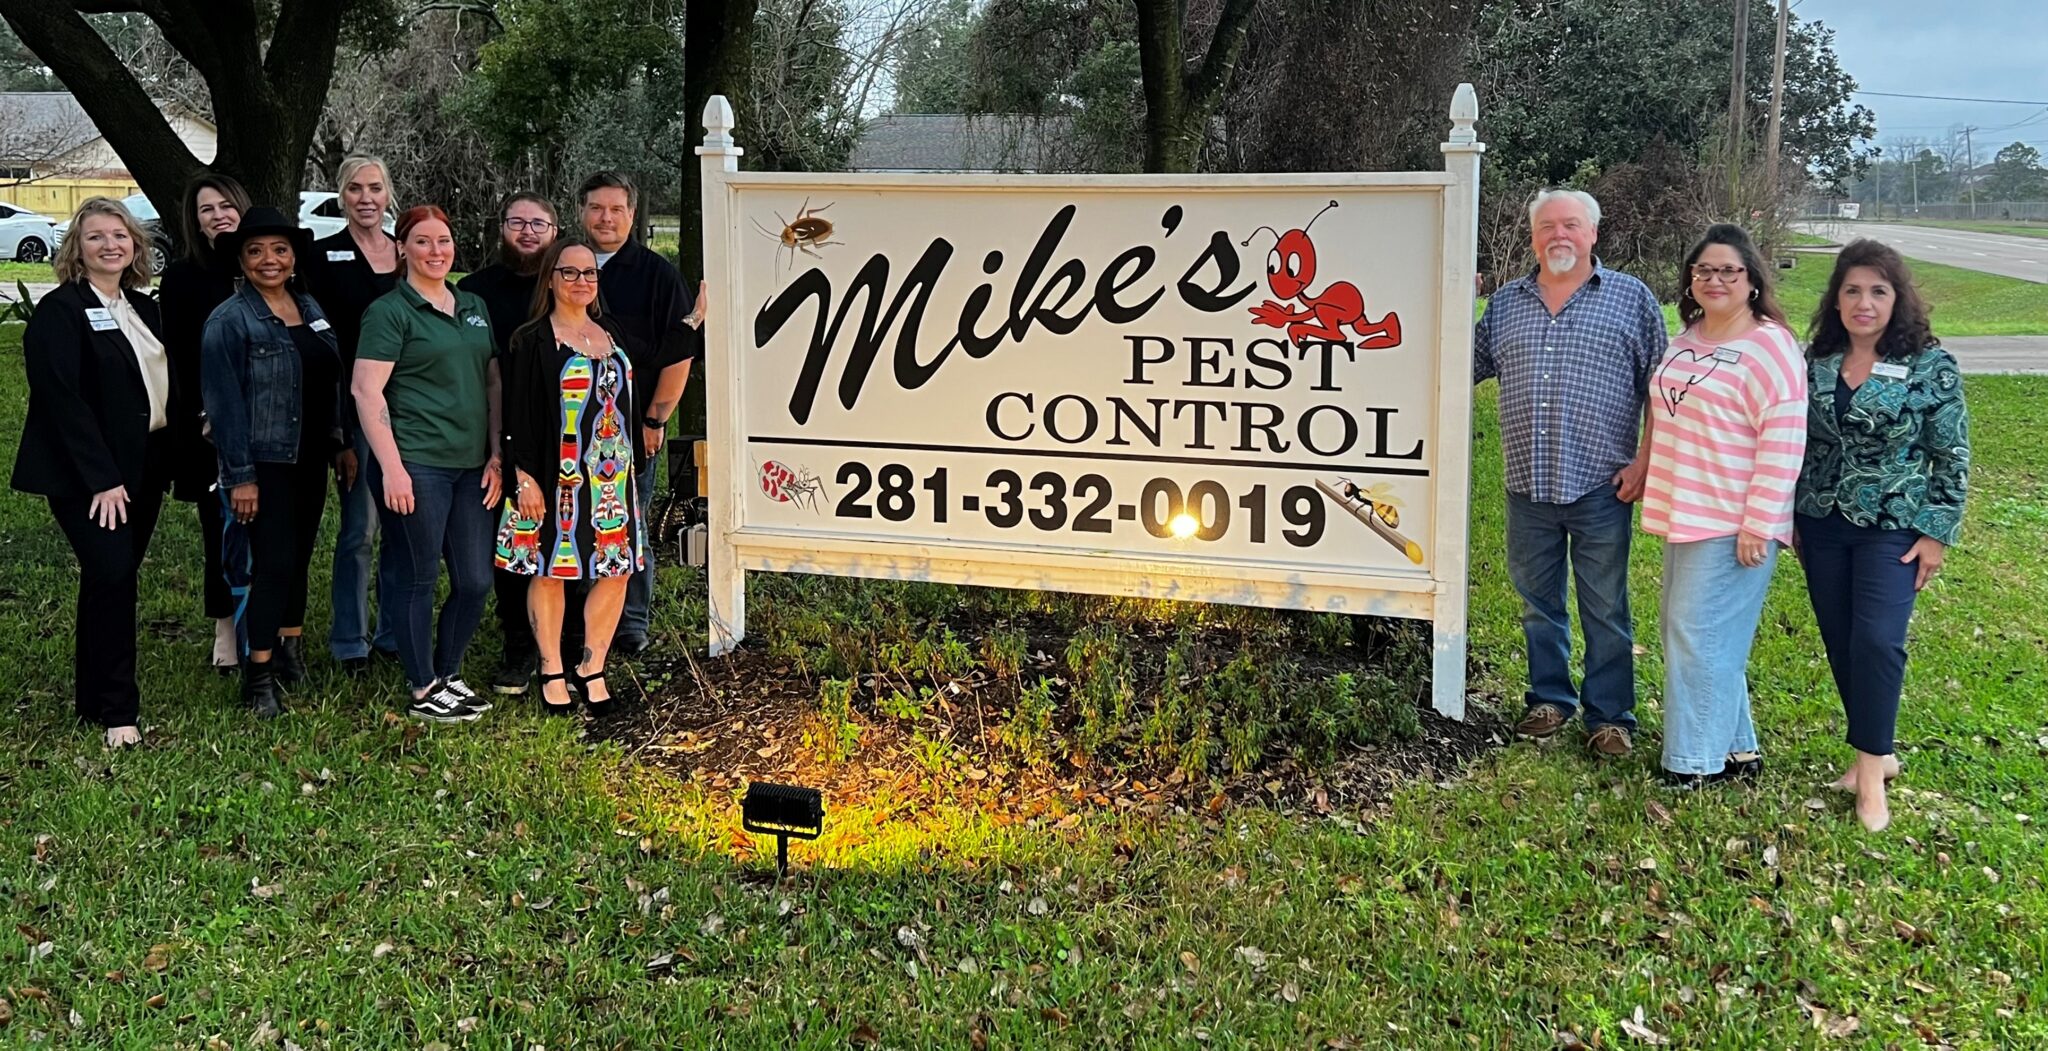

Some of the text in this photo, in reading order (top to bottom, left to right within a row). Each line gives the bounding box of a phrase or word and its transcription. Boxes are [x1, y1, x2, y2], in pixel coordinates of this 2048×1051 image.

[755, 204, 1259, 426] Mike's
[1123, 335, 1356, 392] PEST
[985, 392, 1425, 461] CONTROL
[835, 461, 1327, 548] 281-332-0019
